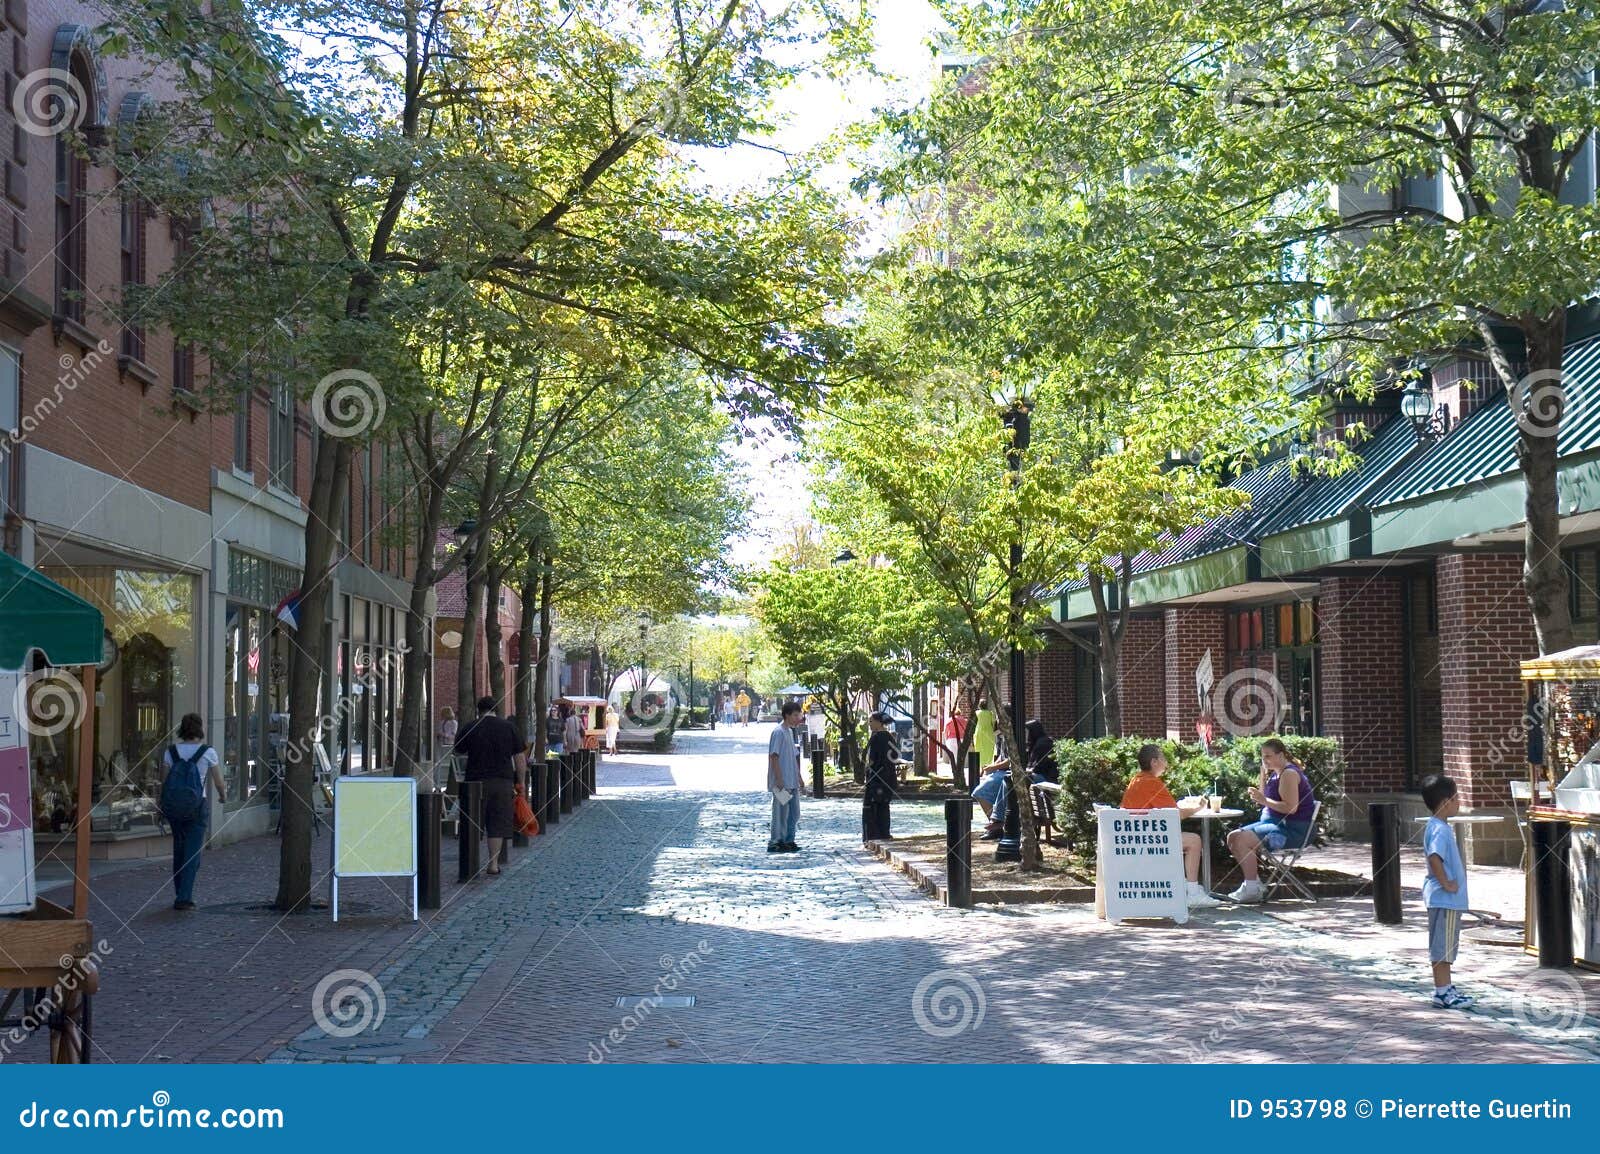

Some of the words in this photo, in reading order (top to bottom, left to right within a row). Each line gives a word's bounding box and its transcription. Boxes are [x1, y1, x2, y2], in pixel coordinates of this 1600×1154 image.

[1113, 819, 1168, 832] CREPES
[1114, 834, 1169, 845] ESPRESSO
[1115, 847, 1137, 855] BEER
[1140, 847, 1144, 855] /
[1147, 847, 1170, 855] WINE
[1118, 881, 1171, 889] REFRESHING
[1118, 890, 1138, 899] ICEY
[1140, 890, 1173, 899] DRINKS
